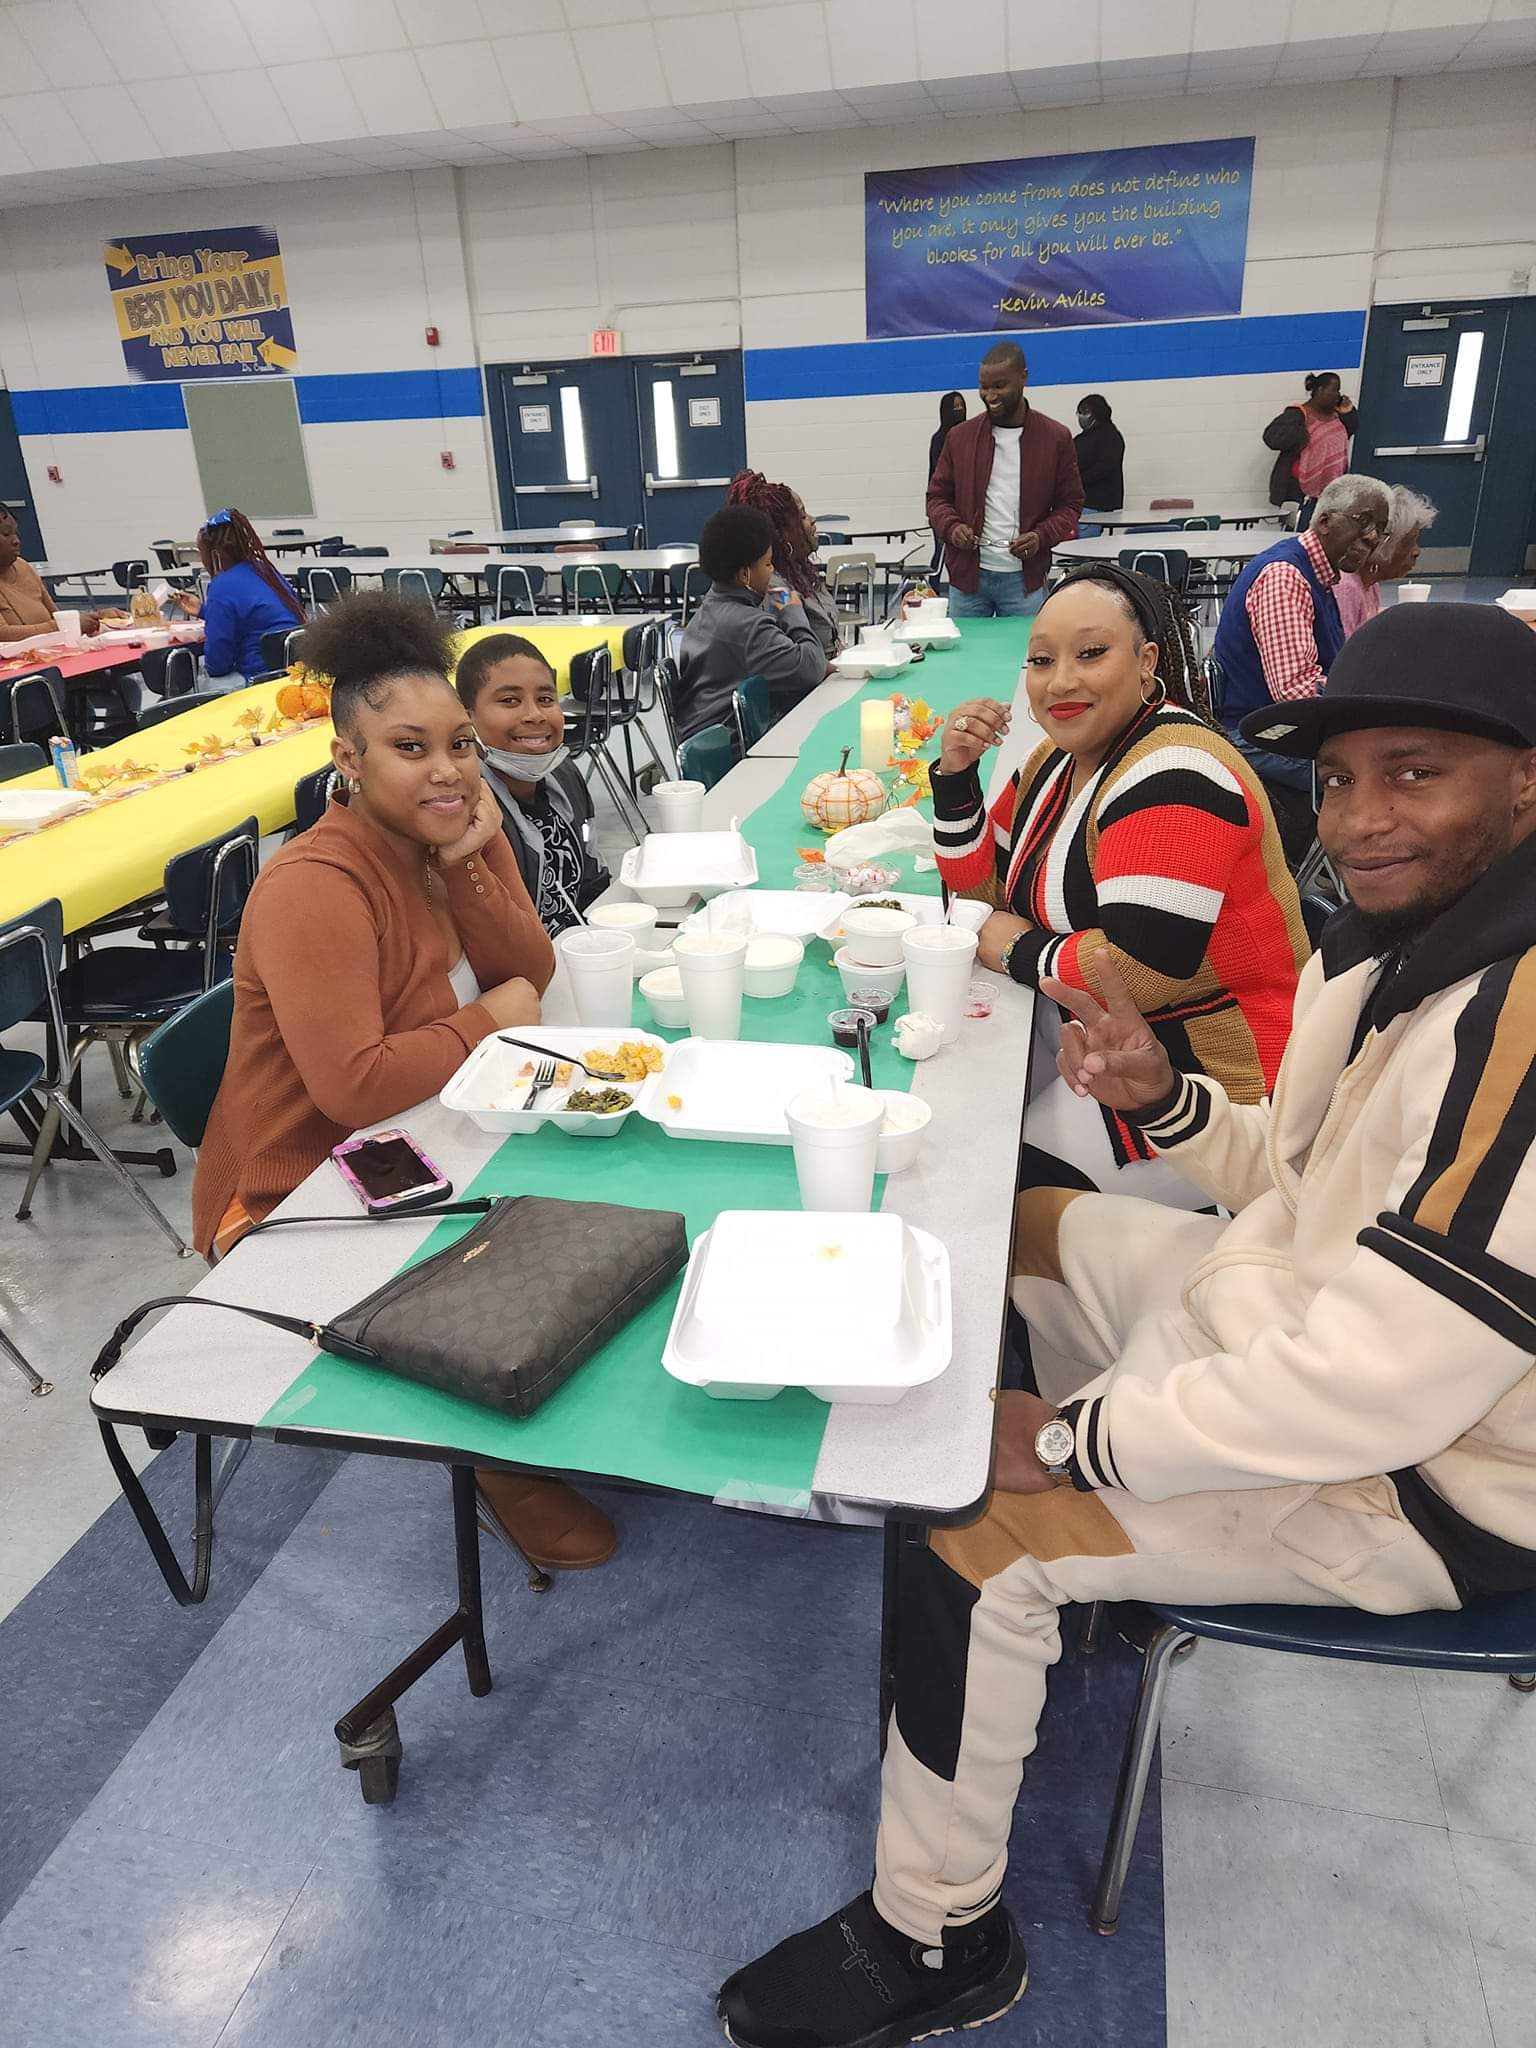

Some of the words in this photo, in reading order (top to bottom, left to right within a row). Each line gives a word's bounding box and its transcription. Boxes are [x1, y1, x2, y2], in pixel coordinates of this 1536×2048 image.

[939, 195, 971, 217] you
[975, 190, 1017, 206] come
[1022, 182, 1063, 208] from
[1068, 179, 1105, 198] does
[1111, 177, 1142, 194] not
[1145, 169, 1200, 194] define
[1205, 167, 1240, 186] who
[892, 225, 922, 248] you
[927, 222, 956, 238] are,
[961, 217, 976, 235] it
[980, 217, 1018, 240] only
[1024, 211, 1068, 235] gives
[1073, 210, 1107, 234] you
[1112, 204, 1138, 222] the
[1143, 197, 1221, 220] building
[135, 251, 195, 281] Bring
[195, 248, 249, 273] Your
[982, 241, 1009, 266] for
[1011, 240, 1034, 258] all
[1038, 242, 1071, 265] you
[1075, 233, 1109, 252] will
[1113, 235, 1148, 251] ever
[123, 291, 170, 332] BEST
[169, 280, 216, 321] YOU
[1053, 289, 1106, 309] Aviles
[150, 326, 184, 347] AND
[184, 320, 223, 344] YOU
[223, 319, 265, 342] WILL
[593, 332, 616, 353] EXIT
[162, 344, 220, 368] NEVER
[219, 342, 257, 365] FAIL
